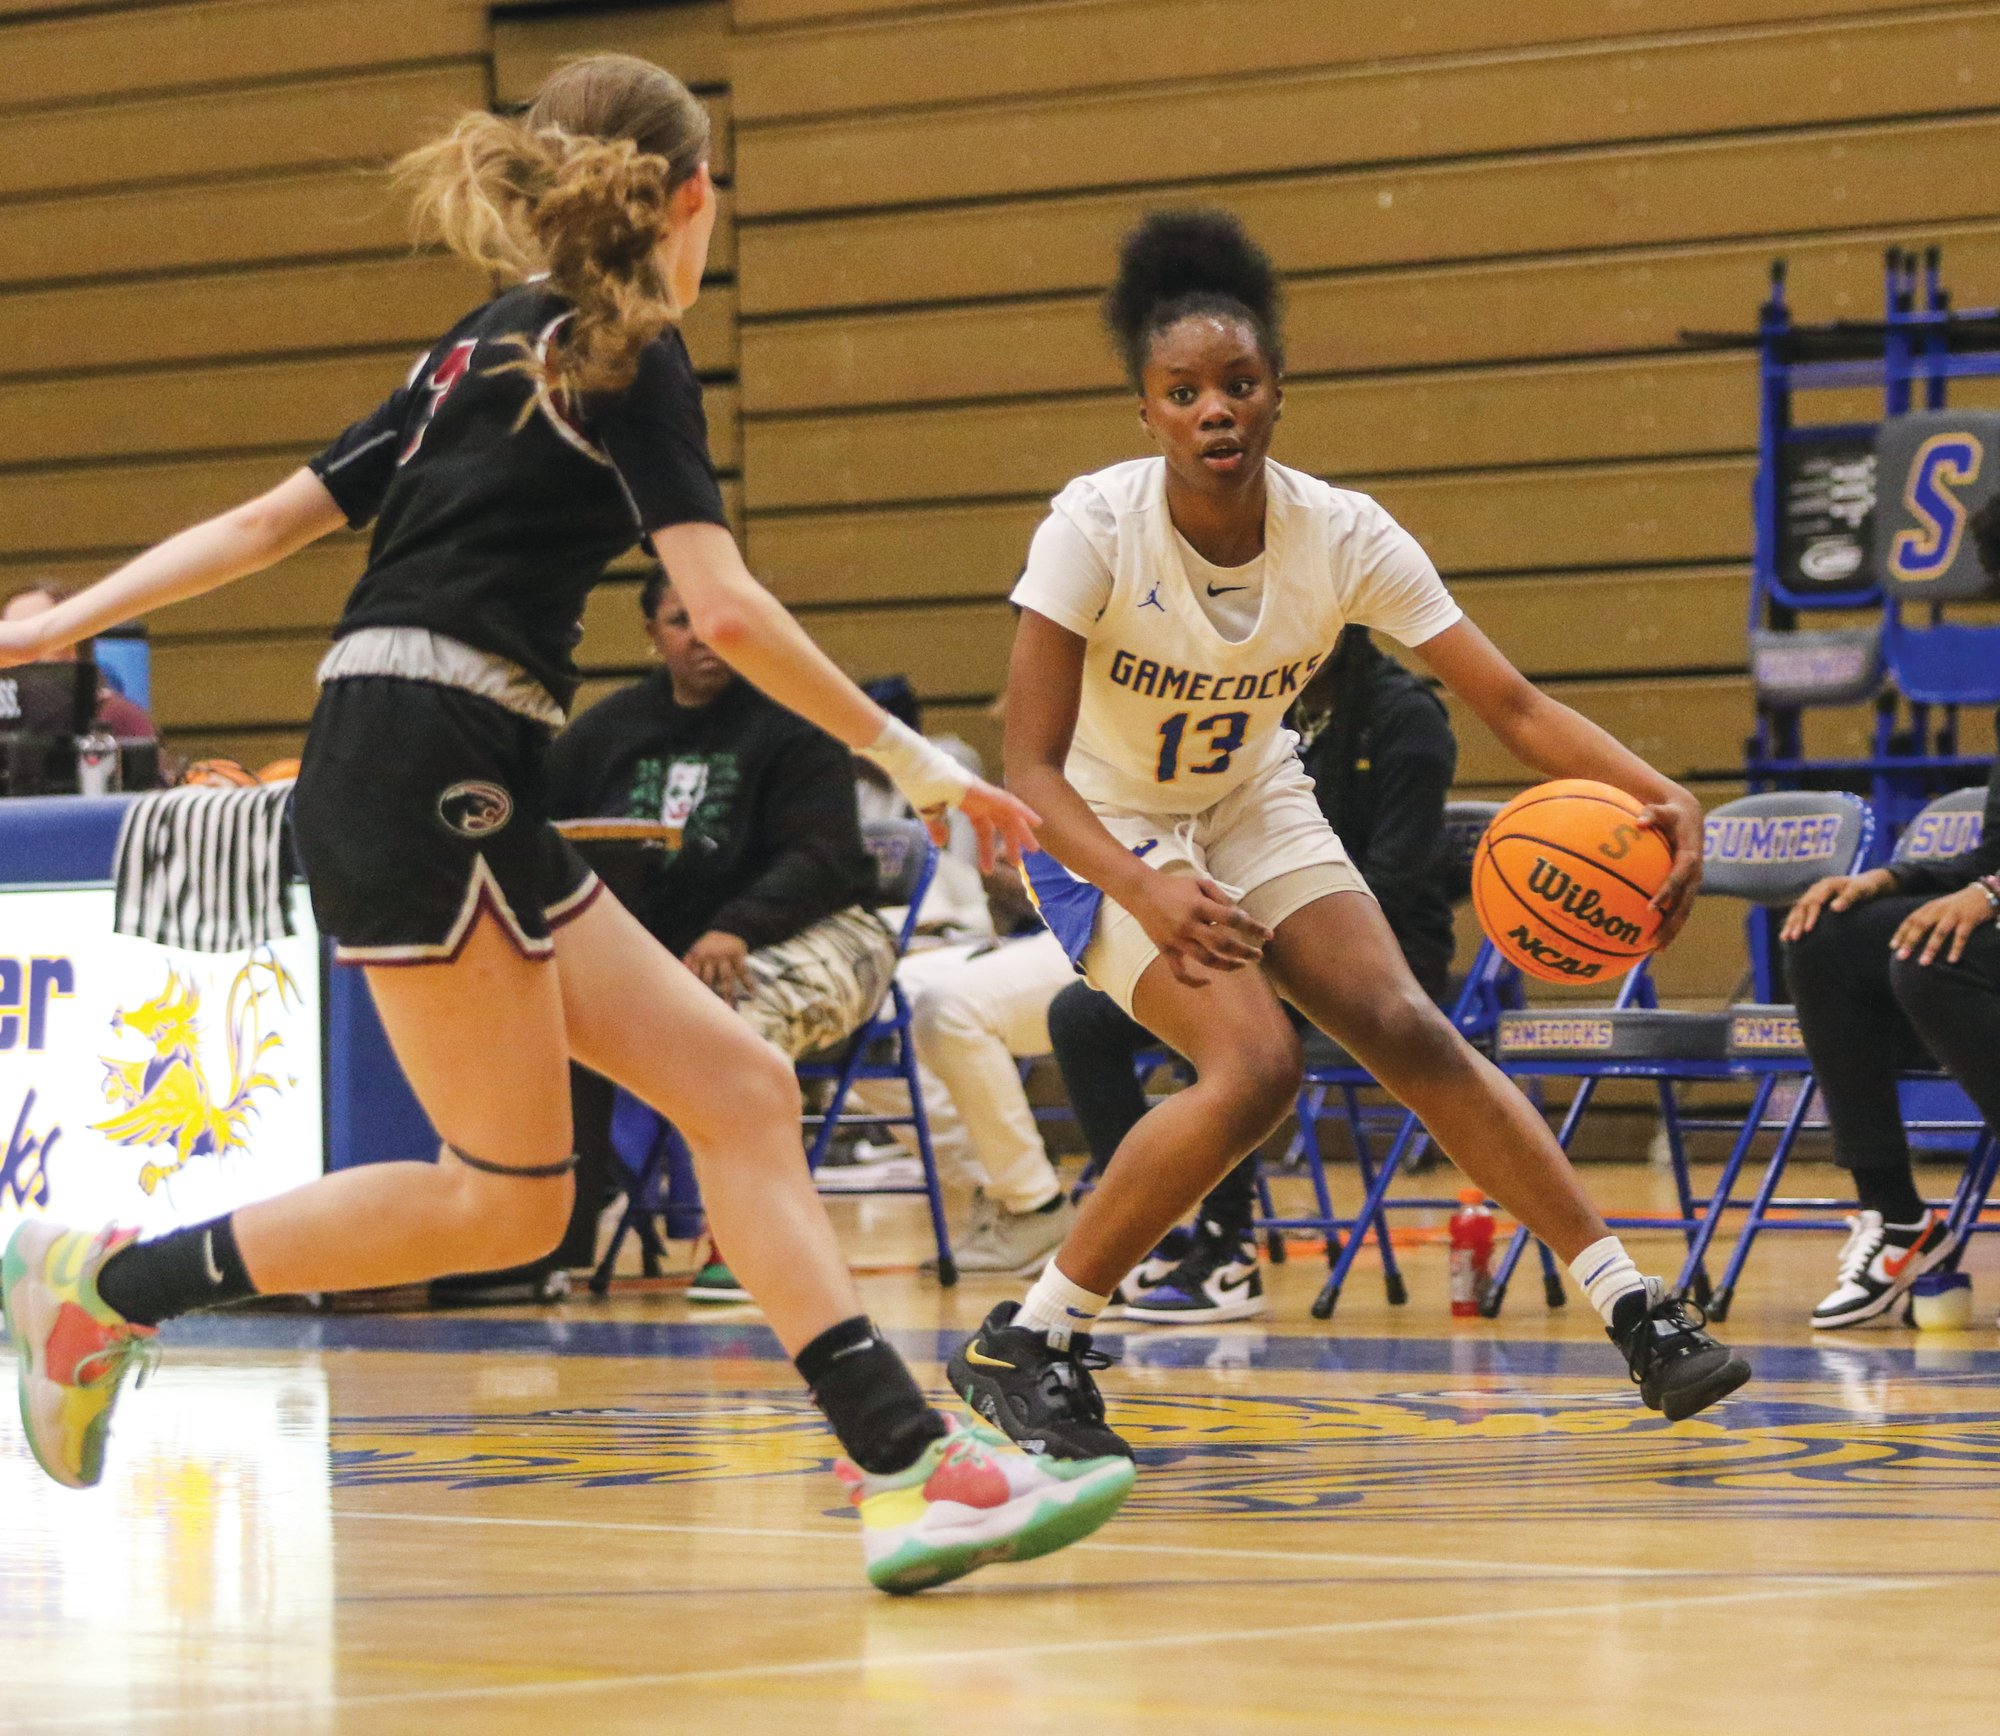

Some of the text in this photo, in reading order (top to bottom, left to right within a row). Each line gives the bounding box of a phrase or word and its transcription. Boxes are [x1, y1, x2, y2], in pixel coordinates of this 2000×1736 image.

[1888, 432, 1983, 582] S
[1155, 711, 1250, 784] 13
[1704, 812, 1844, 864] SUMTER
[1528, 856, 1642, 945] Wilson
[1507, 925, 1602, 978] NCAA
[1500, 1020, 1613, 1050] GAMECOCKS
